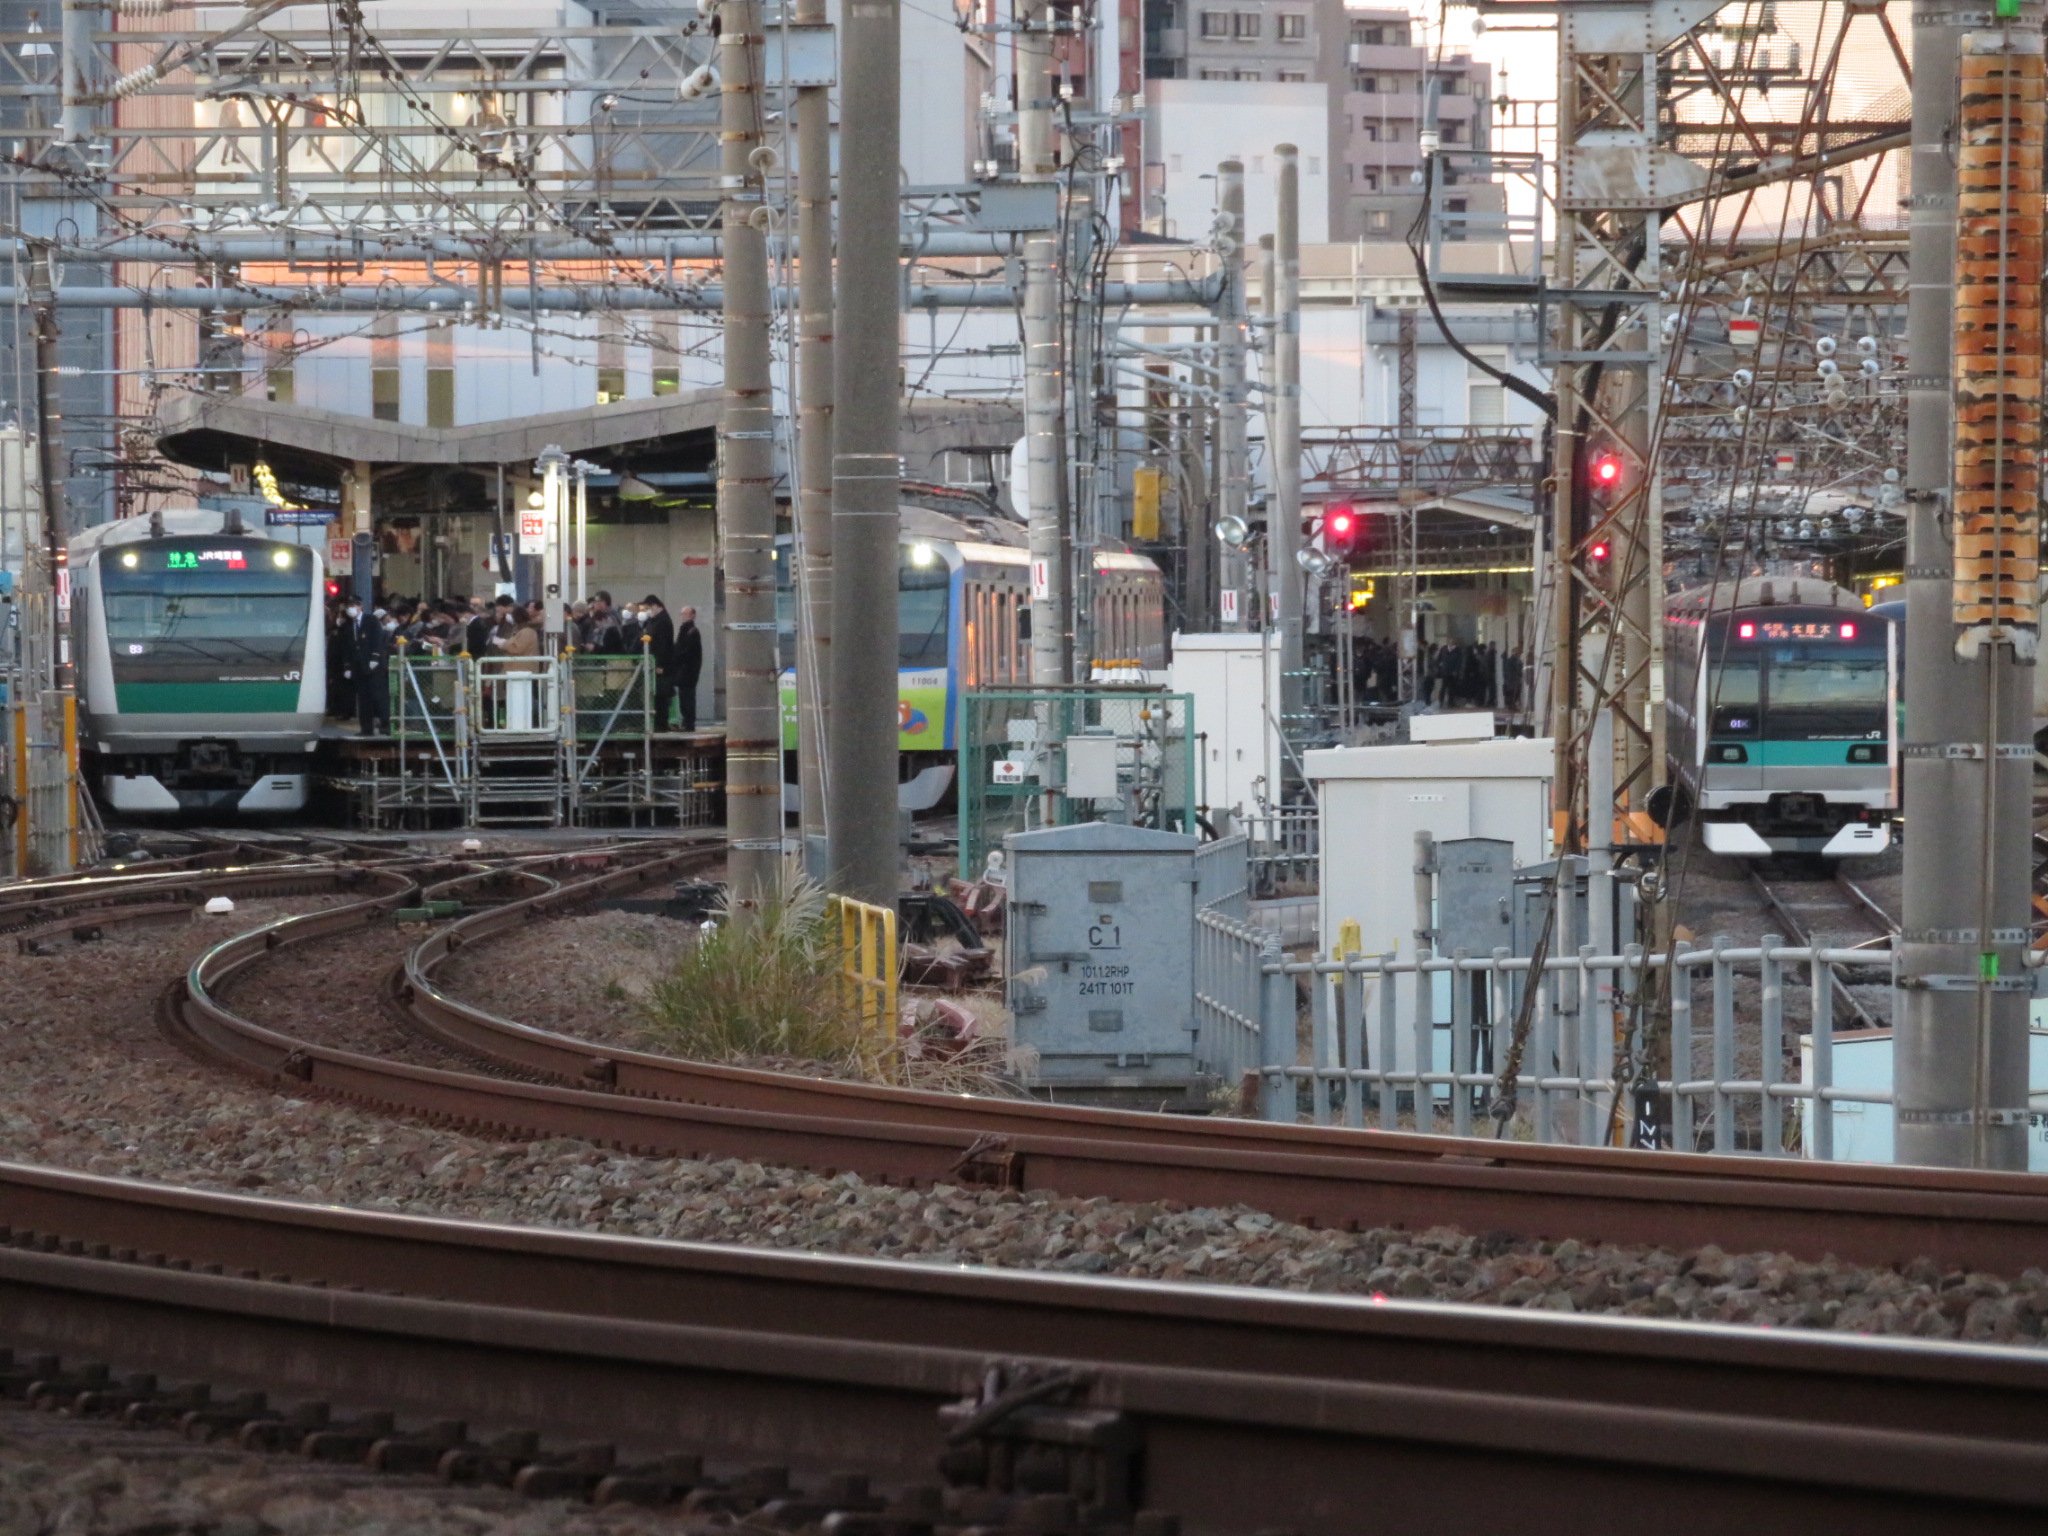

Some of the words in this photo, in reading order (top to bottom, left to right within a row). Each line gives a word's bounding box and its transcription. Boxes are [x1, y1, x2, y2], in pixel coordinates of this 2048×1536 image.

[284, 671, 300, 681] JR
[1866, 731, 1881, 739] JR
[1079, 983, 1107, 995] 241T
[1110, 983, 1134, 995] 101T
